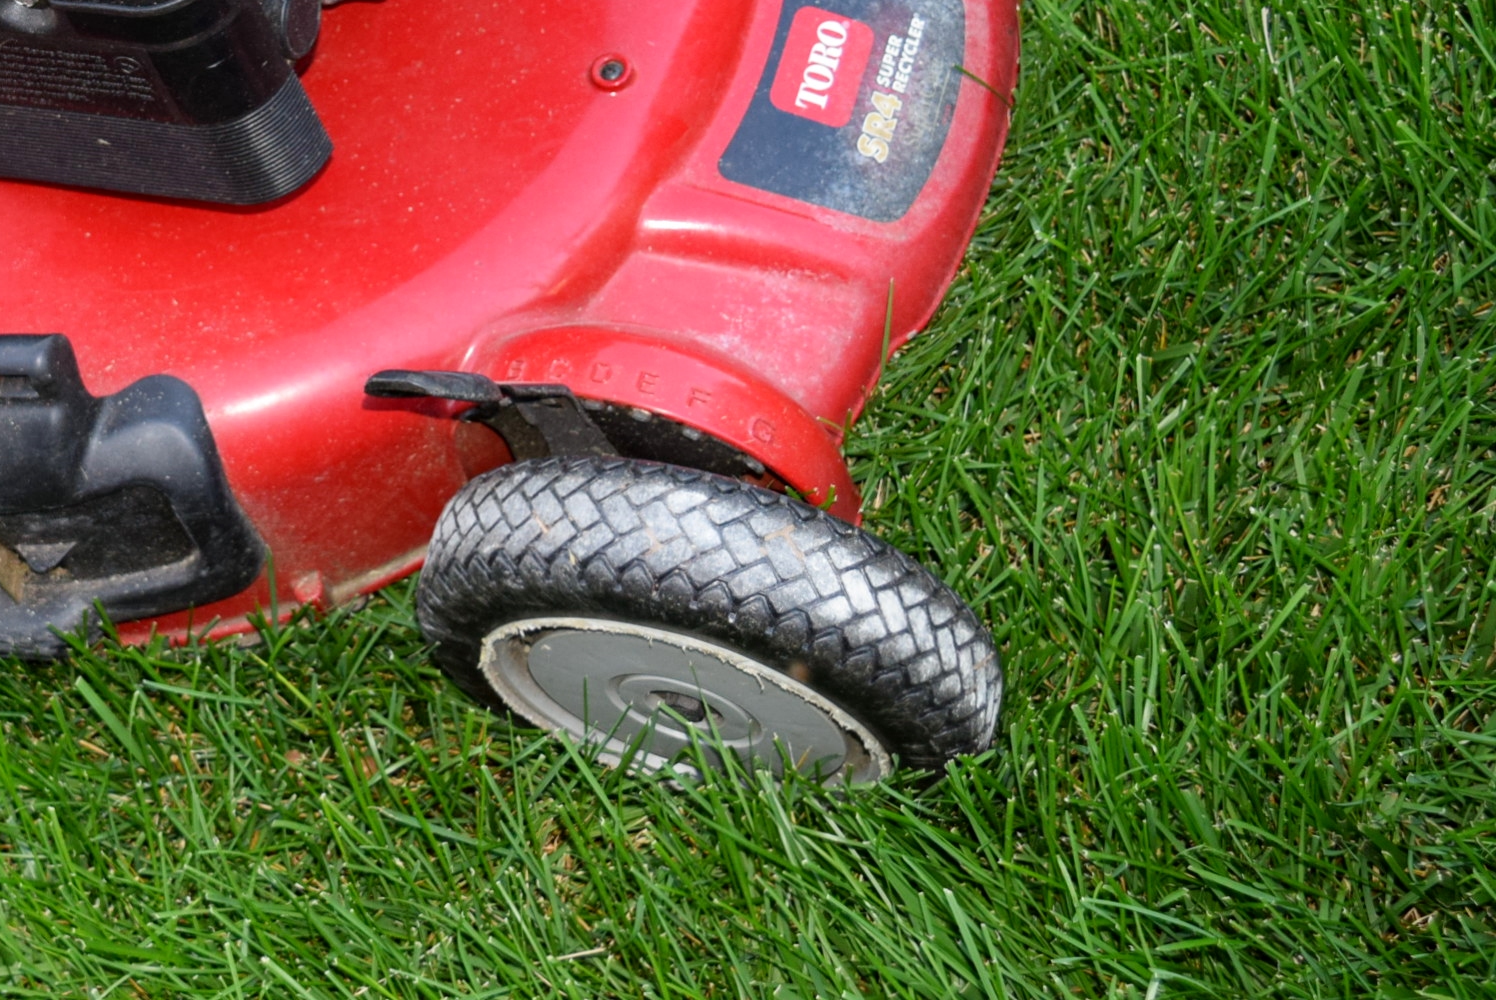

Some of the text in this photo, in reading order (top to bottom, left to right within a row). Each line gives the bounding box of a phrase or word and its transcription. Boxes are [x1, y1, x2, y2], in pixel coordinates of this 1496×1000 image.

[795, 20, 848, 110] TORO
[892, 15, 925, 94] RECYCLER
[857, 34, 902, 163] SR4 SUPER
[637, 371, 659, 395] E
[688, 387, 712, 407] F
